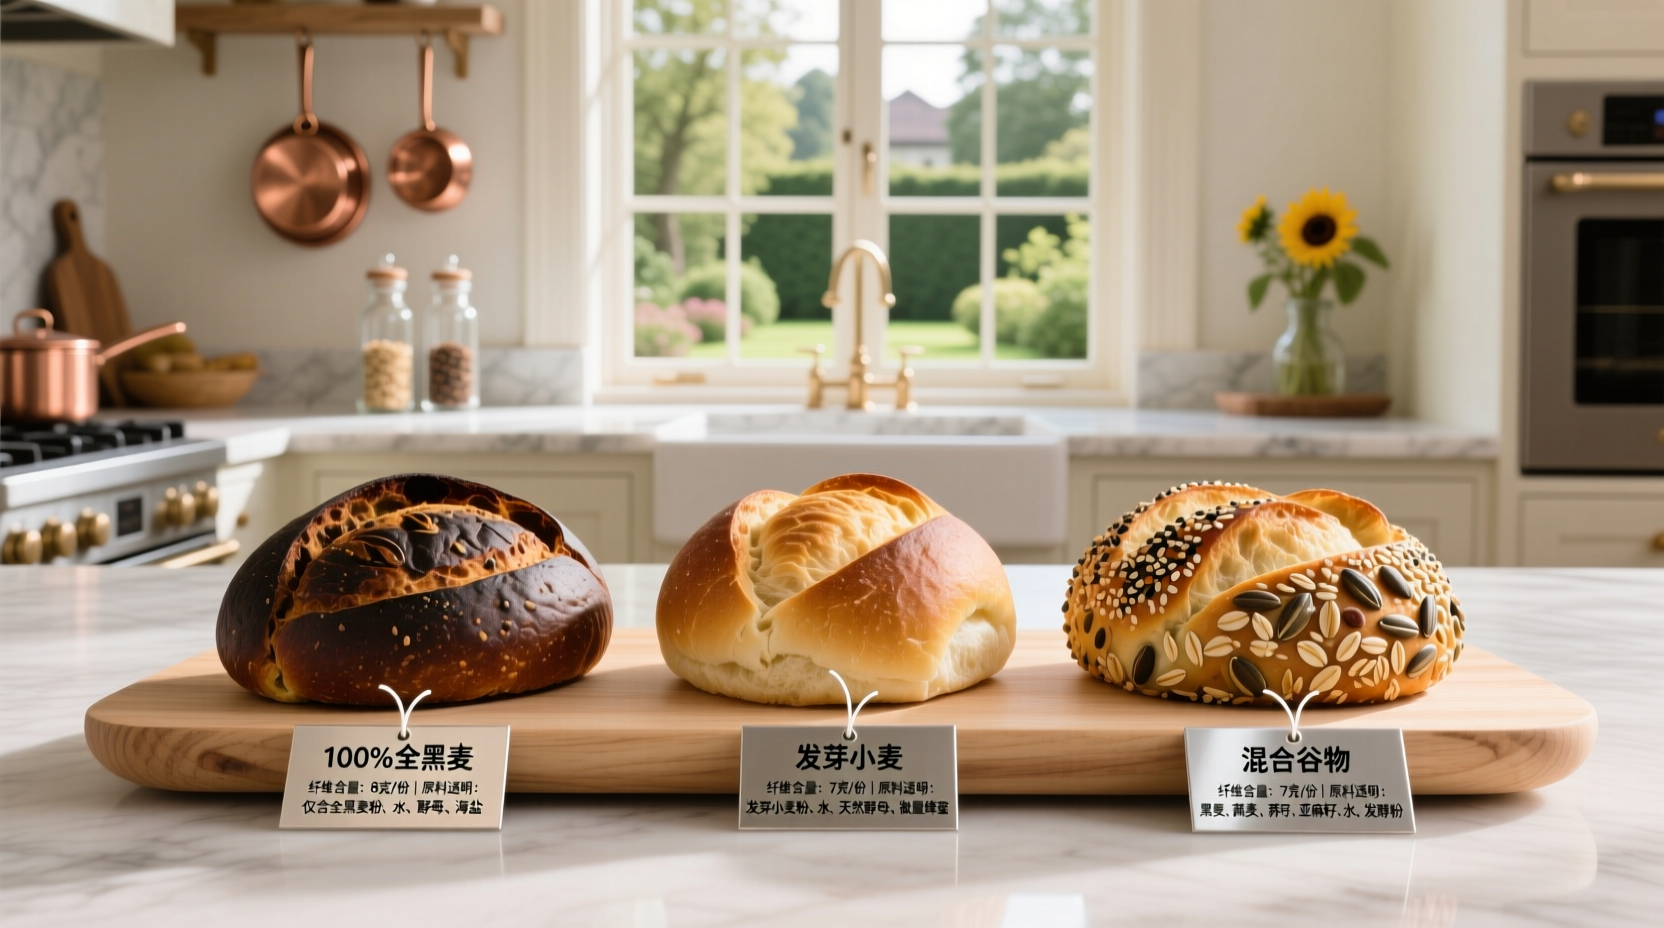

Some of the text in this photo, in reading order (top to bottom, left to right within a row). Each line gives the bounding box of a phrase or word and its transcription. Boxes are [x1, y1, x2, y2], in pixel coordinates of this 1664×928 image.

[325, 743, 474, 771] 100%全黑麦
[795, 744, 903, 771] 发芽小麦
[1241, 745, 1351, 773] 混合谷物
